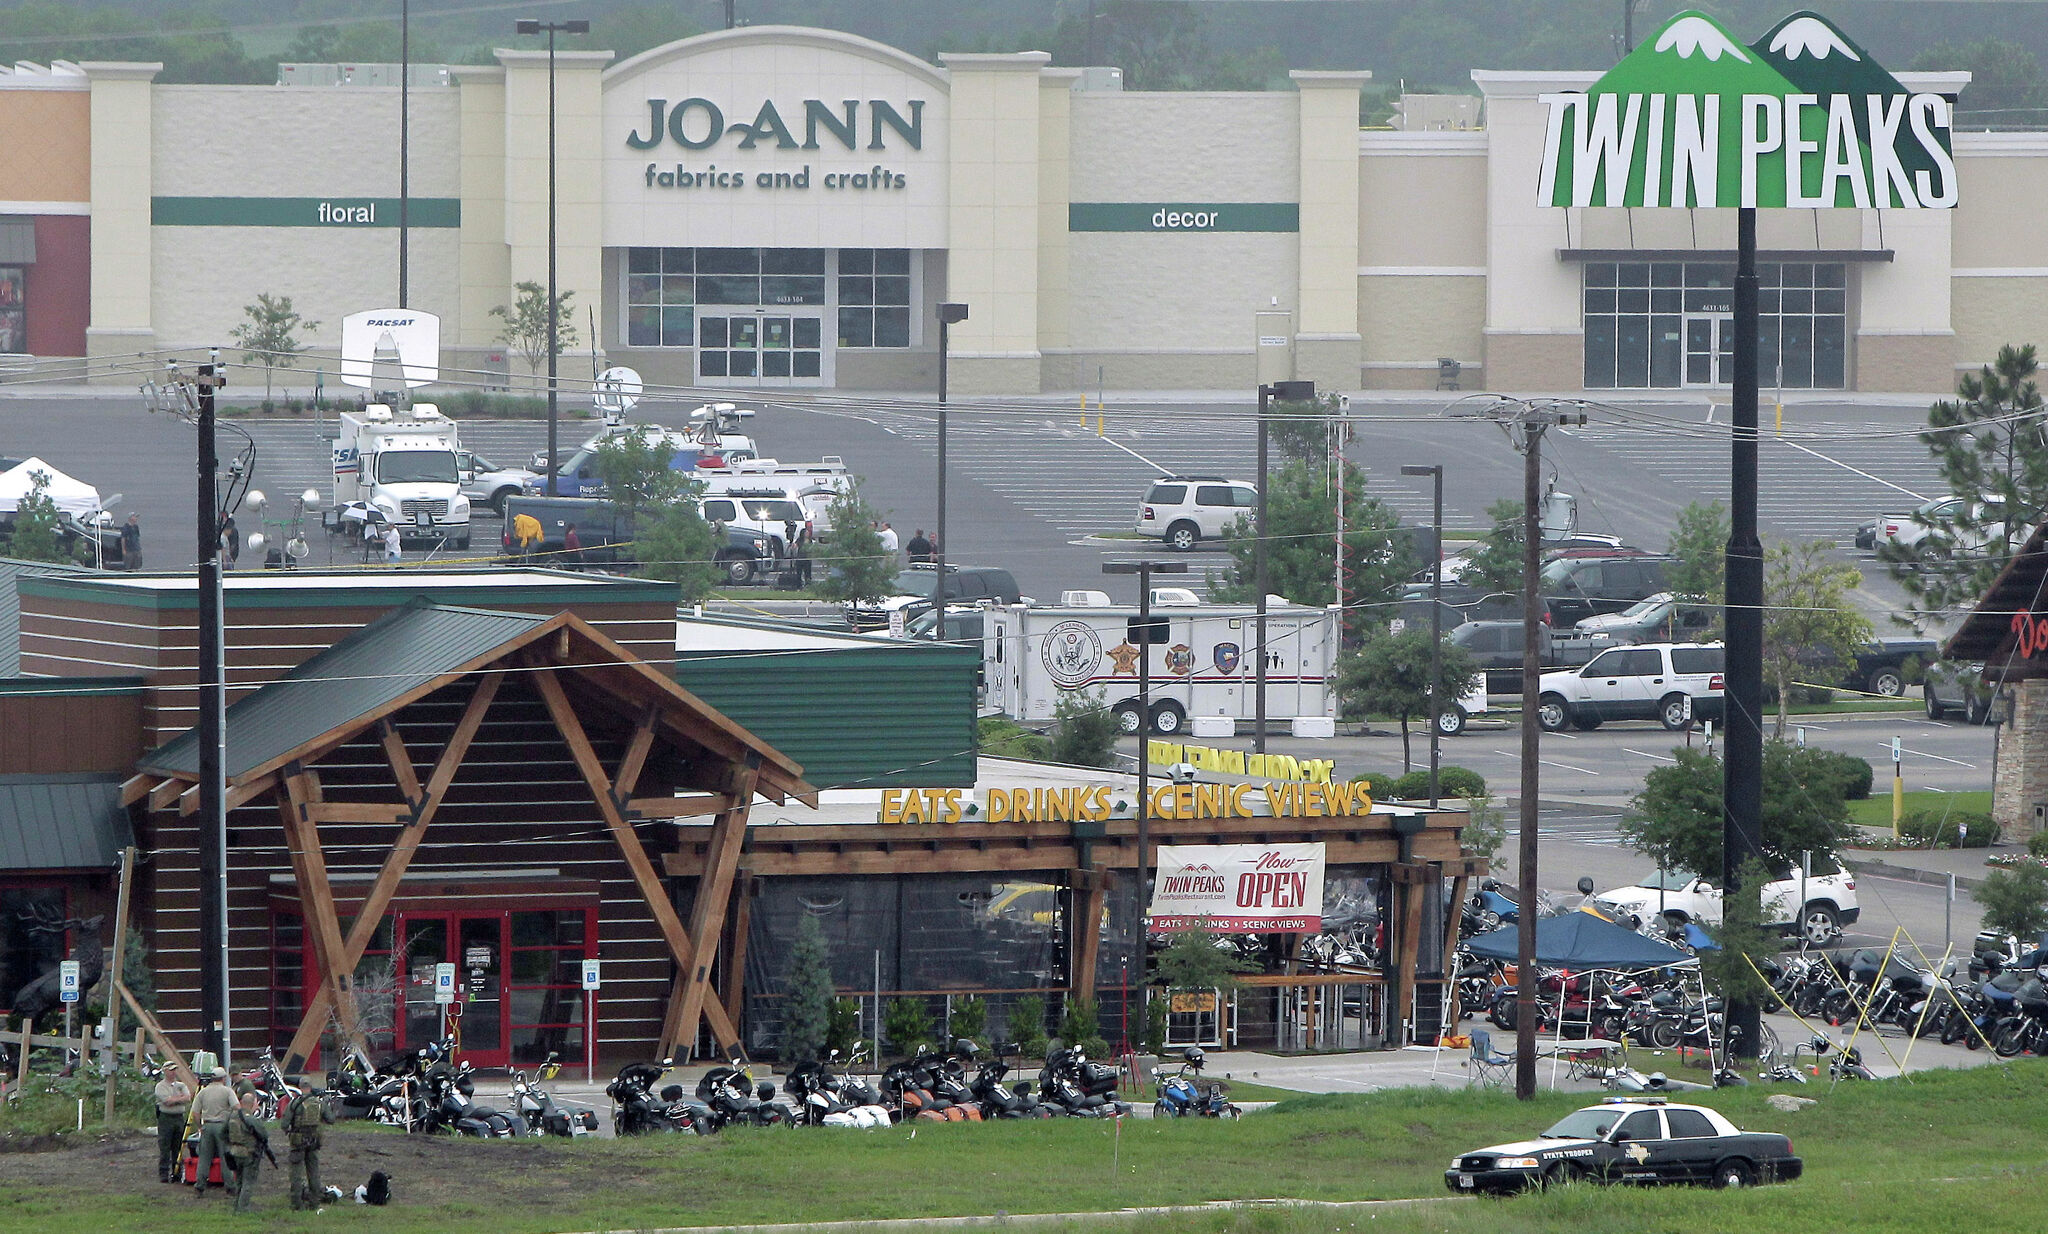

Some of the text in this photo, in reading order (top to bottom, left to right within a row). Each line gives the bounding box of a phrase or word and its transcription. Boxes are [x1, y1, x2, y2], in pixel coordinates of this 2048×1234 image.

[1537, 93, 1959, 208] TWIN PEAKS
[645, 163, 906, 188] fabrics and crafts
[318, 203, 375, 223] floral
[1152, 208, 1218, 227] decor
[366, 319, 415, 327] PACSAT
[880, 789, 963, 824] EATS
[987, 785, 1112, 823] DRINKS
[1263, 781, 1372, 818] VIEWS
[1256, 851, 1298, 871] Now
[1163, 875, 1225, 893] TWIN PEAKS
[1236, 872, 1308, 908] OPEN
[1159, 919, 1306, 928] EATS DINKS SCENIC VIEWS
[1542, 1149, 1594, 1160] STATE TROOPER
